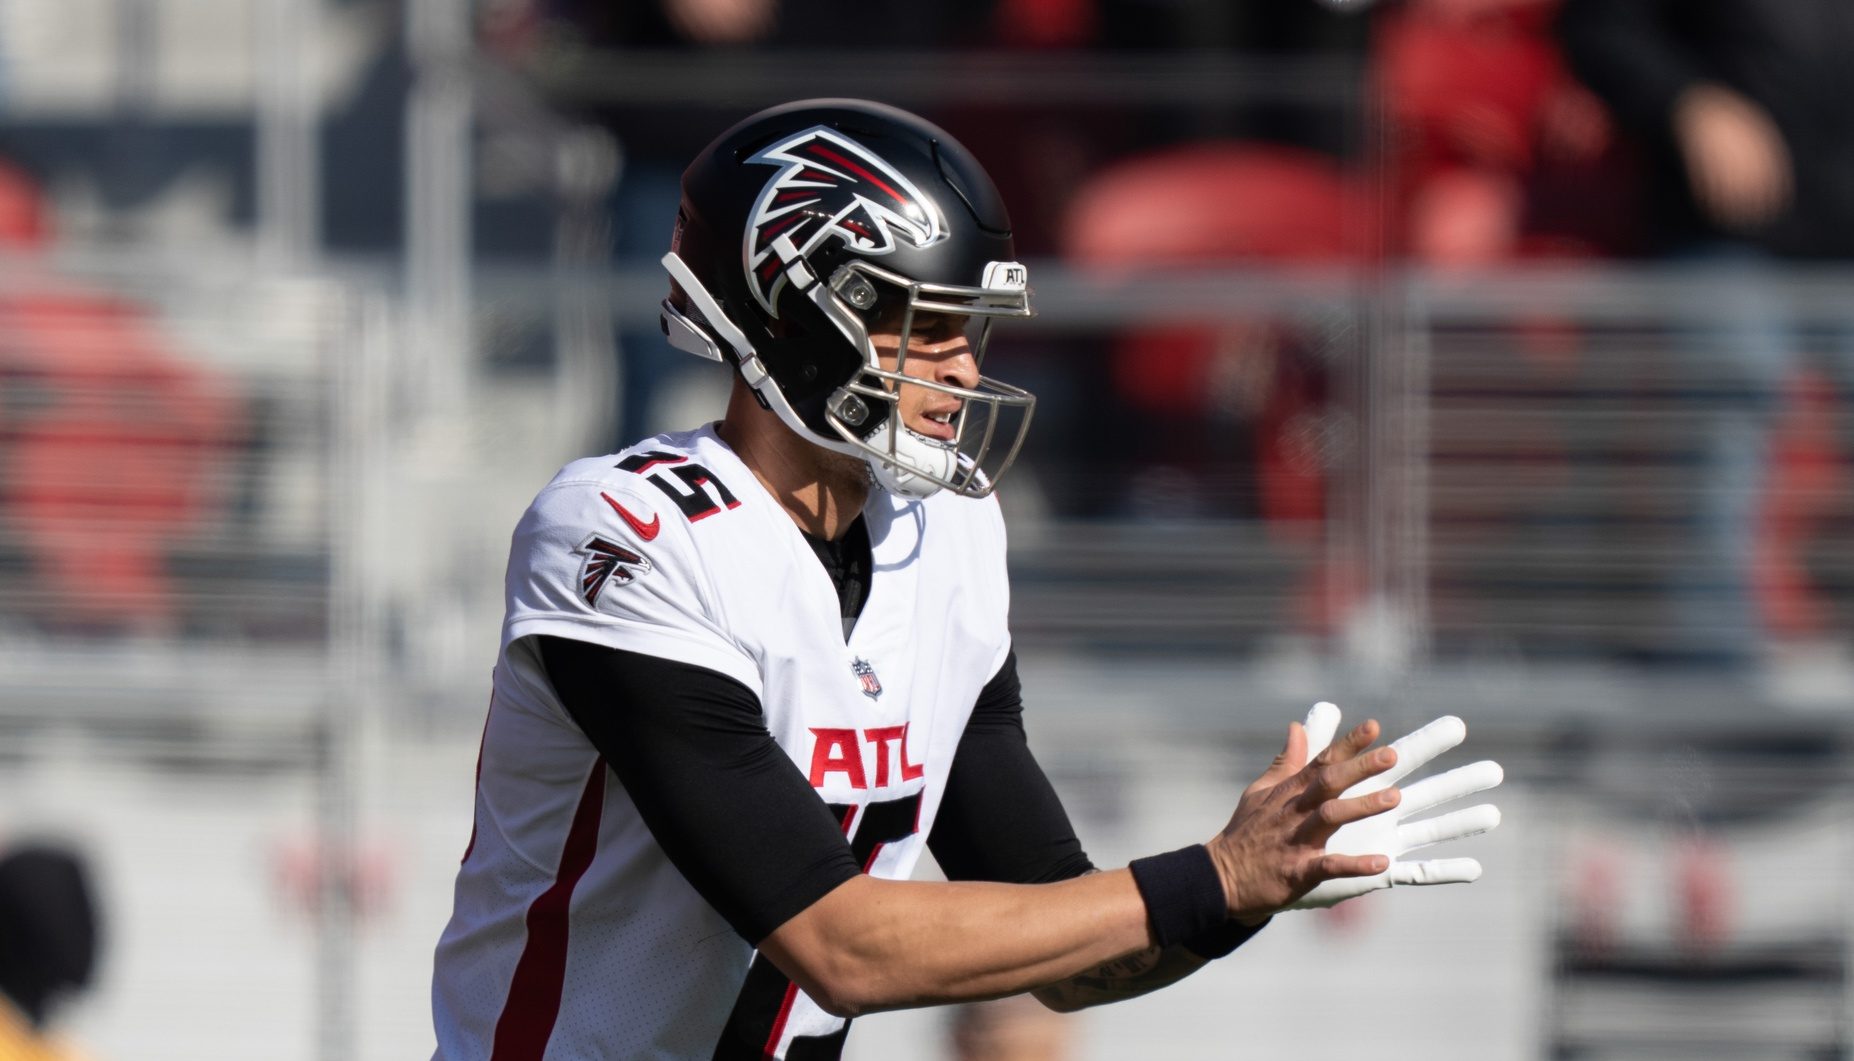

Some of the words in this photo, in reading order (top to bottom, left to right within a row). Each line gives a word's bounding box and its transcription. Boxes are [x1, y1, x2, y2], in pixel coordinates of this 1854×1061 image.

[1005, 268, 1025, 284] ATL
[613, 450, 742, 524] 15
[808, 721, 924, 790] ATL
